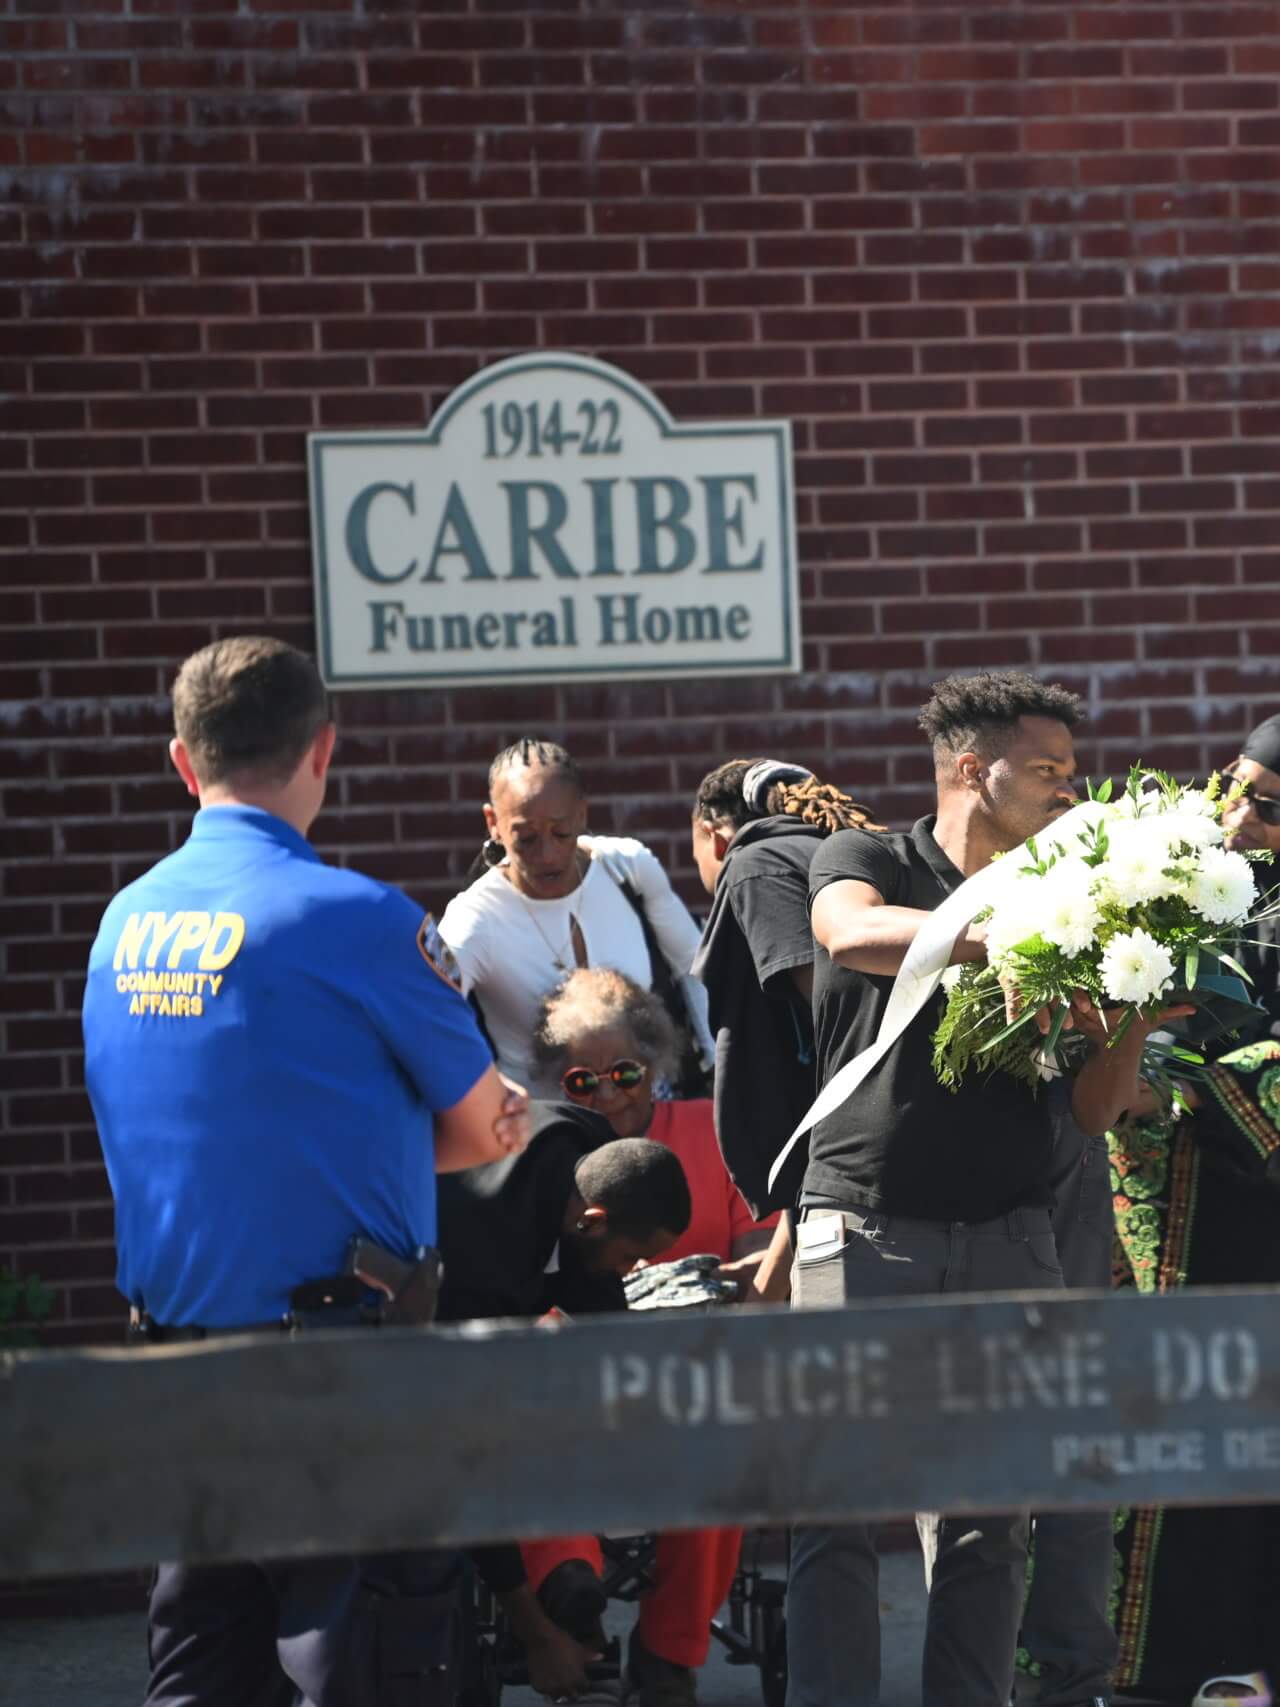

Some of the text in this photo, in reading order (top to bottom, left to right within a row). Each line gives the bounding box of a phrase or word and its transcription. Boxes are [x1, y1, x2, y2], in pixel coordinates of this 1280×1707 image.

[481, 399, 622, 459] 1914-22
[344, 474, 766, 585] CARIBE
[368, 592, 752, 655] Funeral Home
[113, 911, 245, 971] NYPD
[115, 972, 224, 996] COMMUNITY
[128, 994, 204, 1016] AFFAIRS
[601, 1339, 893, 1430] POLICE
[936, 1330, 1108, 1413] LINE
[1153, 1327, 1257, 1402] DO
[1051, 1432, 1206, 1476] POLICE
